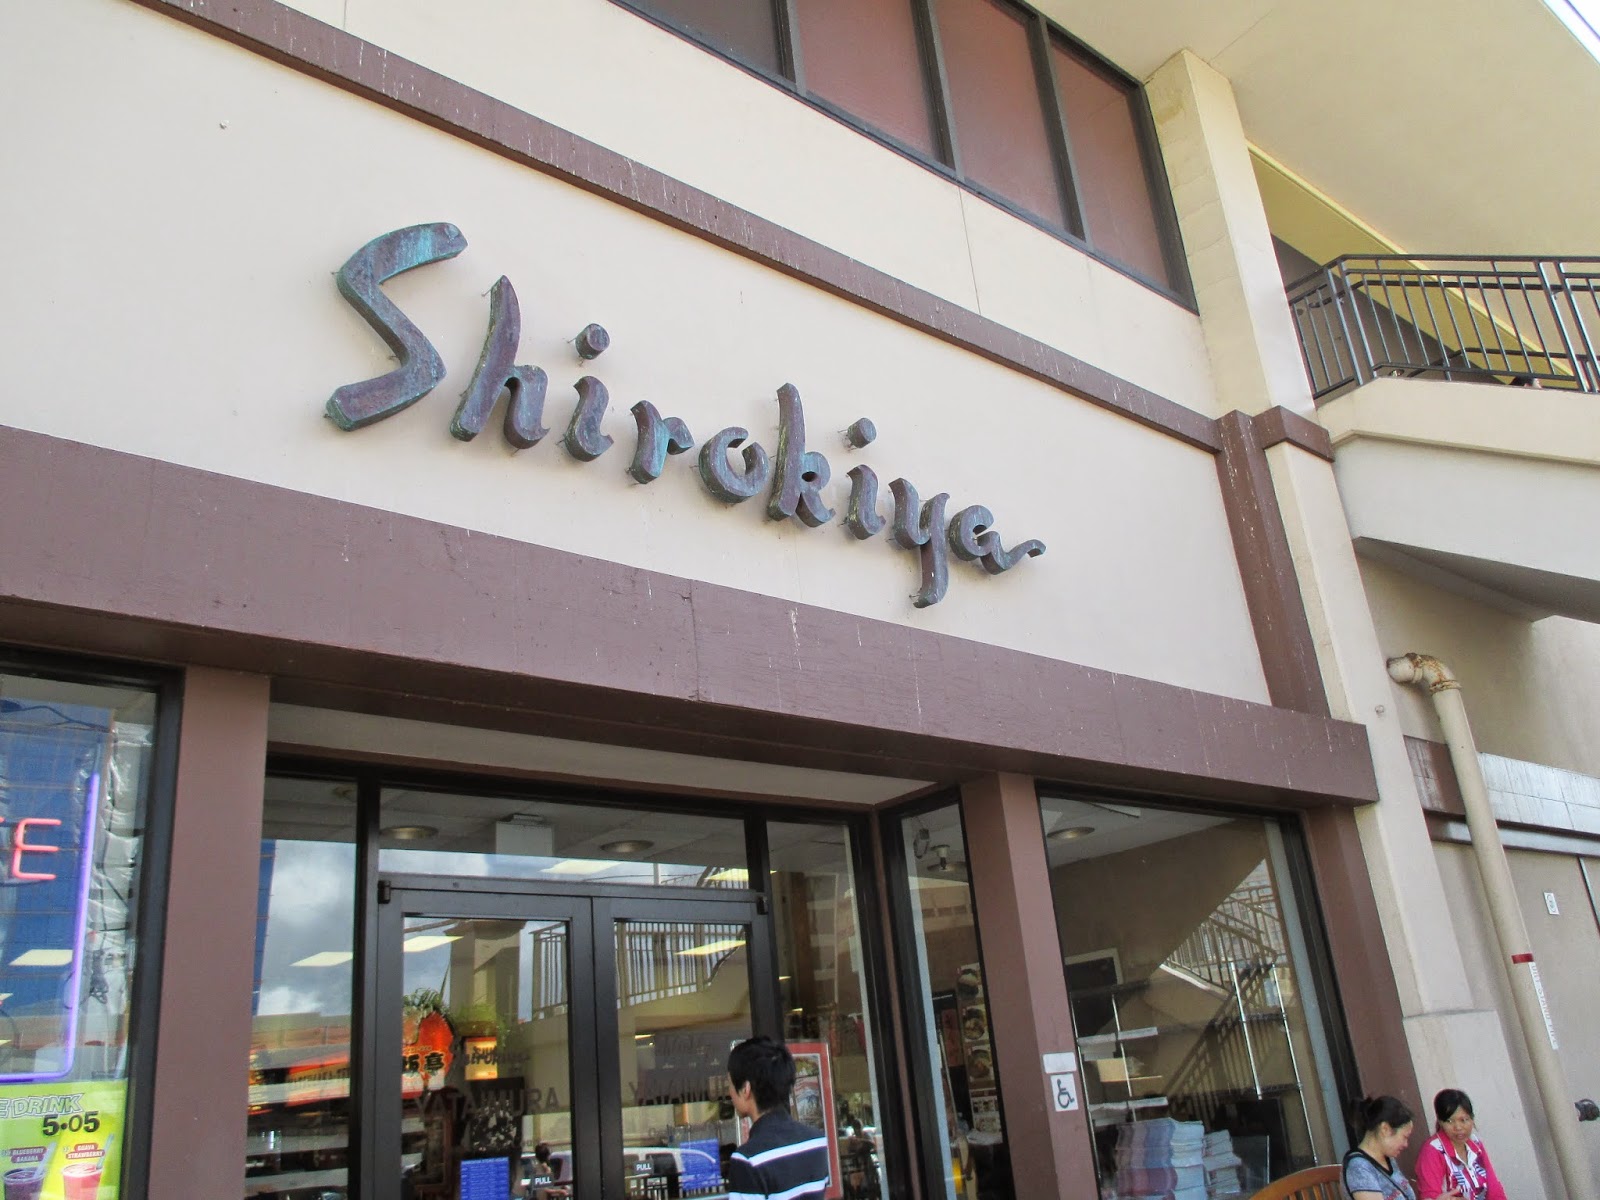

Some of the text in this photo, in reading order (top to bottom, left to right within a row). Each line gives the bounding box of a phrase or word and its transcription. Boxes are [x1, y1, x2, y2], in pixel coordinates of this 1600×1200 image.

[325, 222, 1046, 608] Shirokiya
[11, 1093, 84, 1118] DRINK
[636, 1163, 652, 1171] PULL
[534, 1177, 552, 1185] PULL
